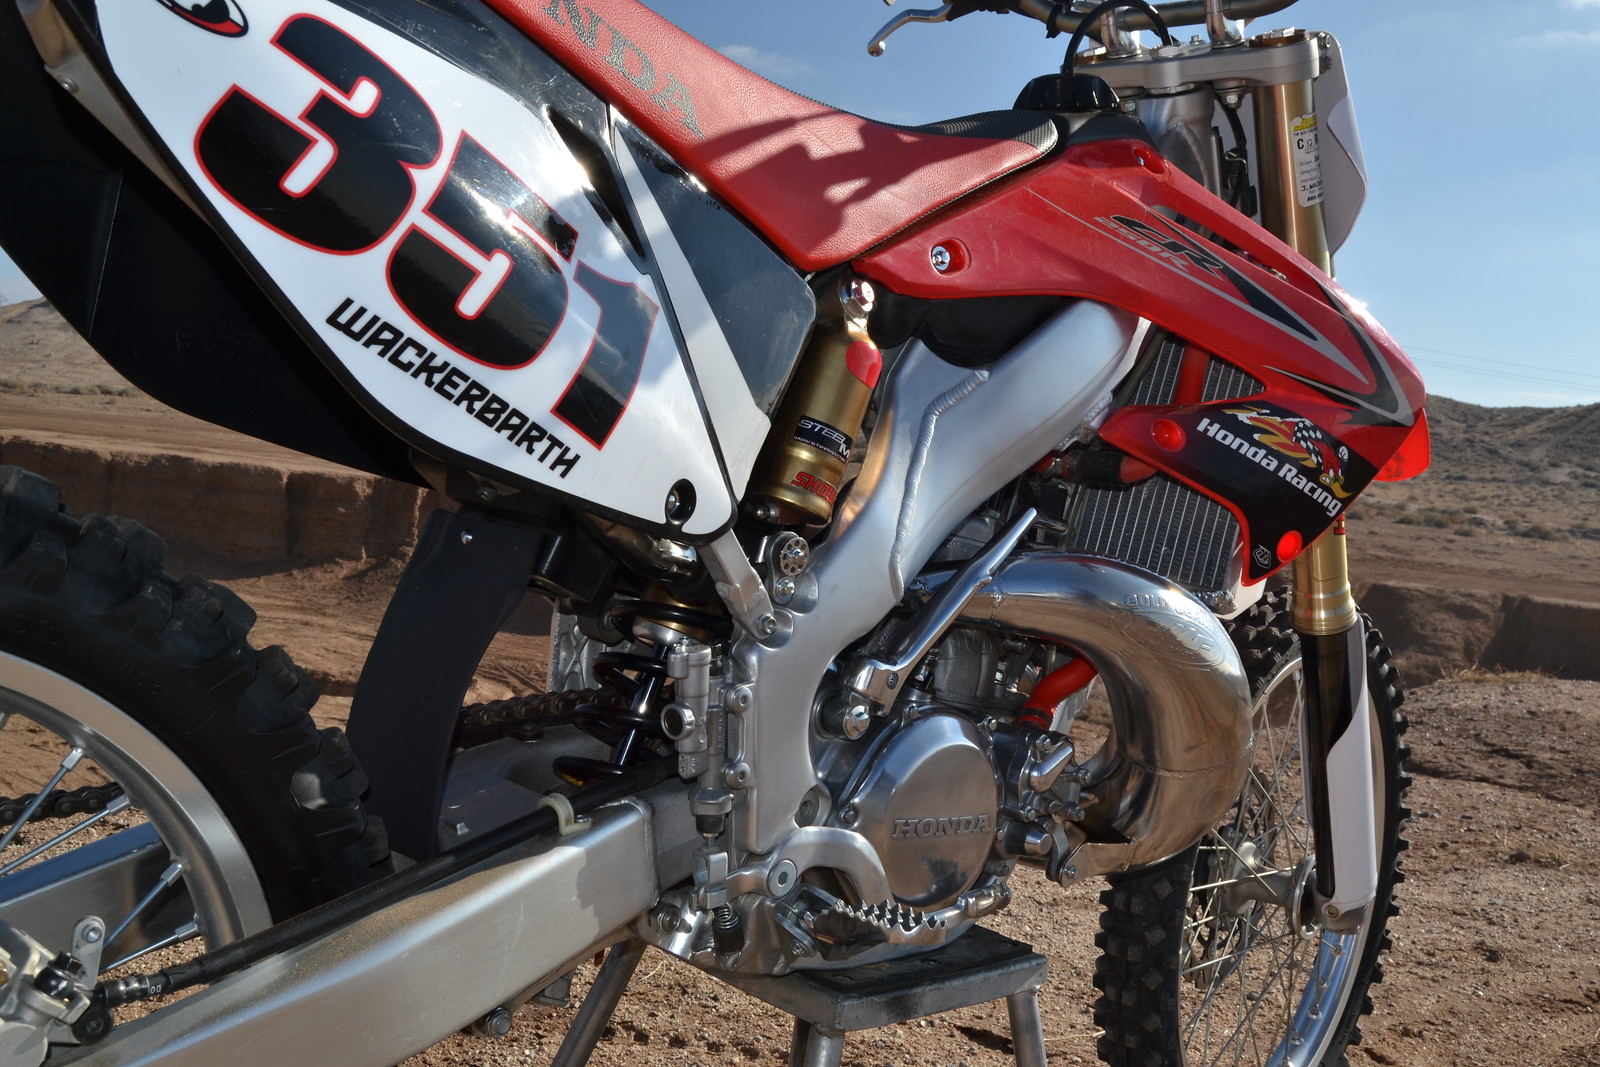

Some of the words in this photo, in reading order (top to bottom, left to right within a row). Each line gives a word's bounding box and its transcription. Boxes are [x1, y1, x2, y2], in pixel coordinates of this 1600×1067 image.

[194, 13, 659, 451] 351
[1111, 214, 1225, 282] CR
[325, 297, 581, 479] WACKERBARTH
[1196, 417, 1279, 472] Honda
[1277, 462, 1343, 518] Racing
[891, 814, 992, 840] HONDA
